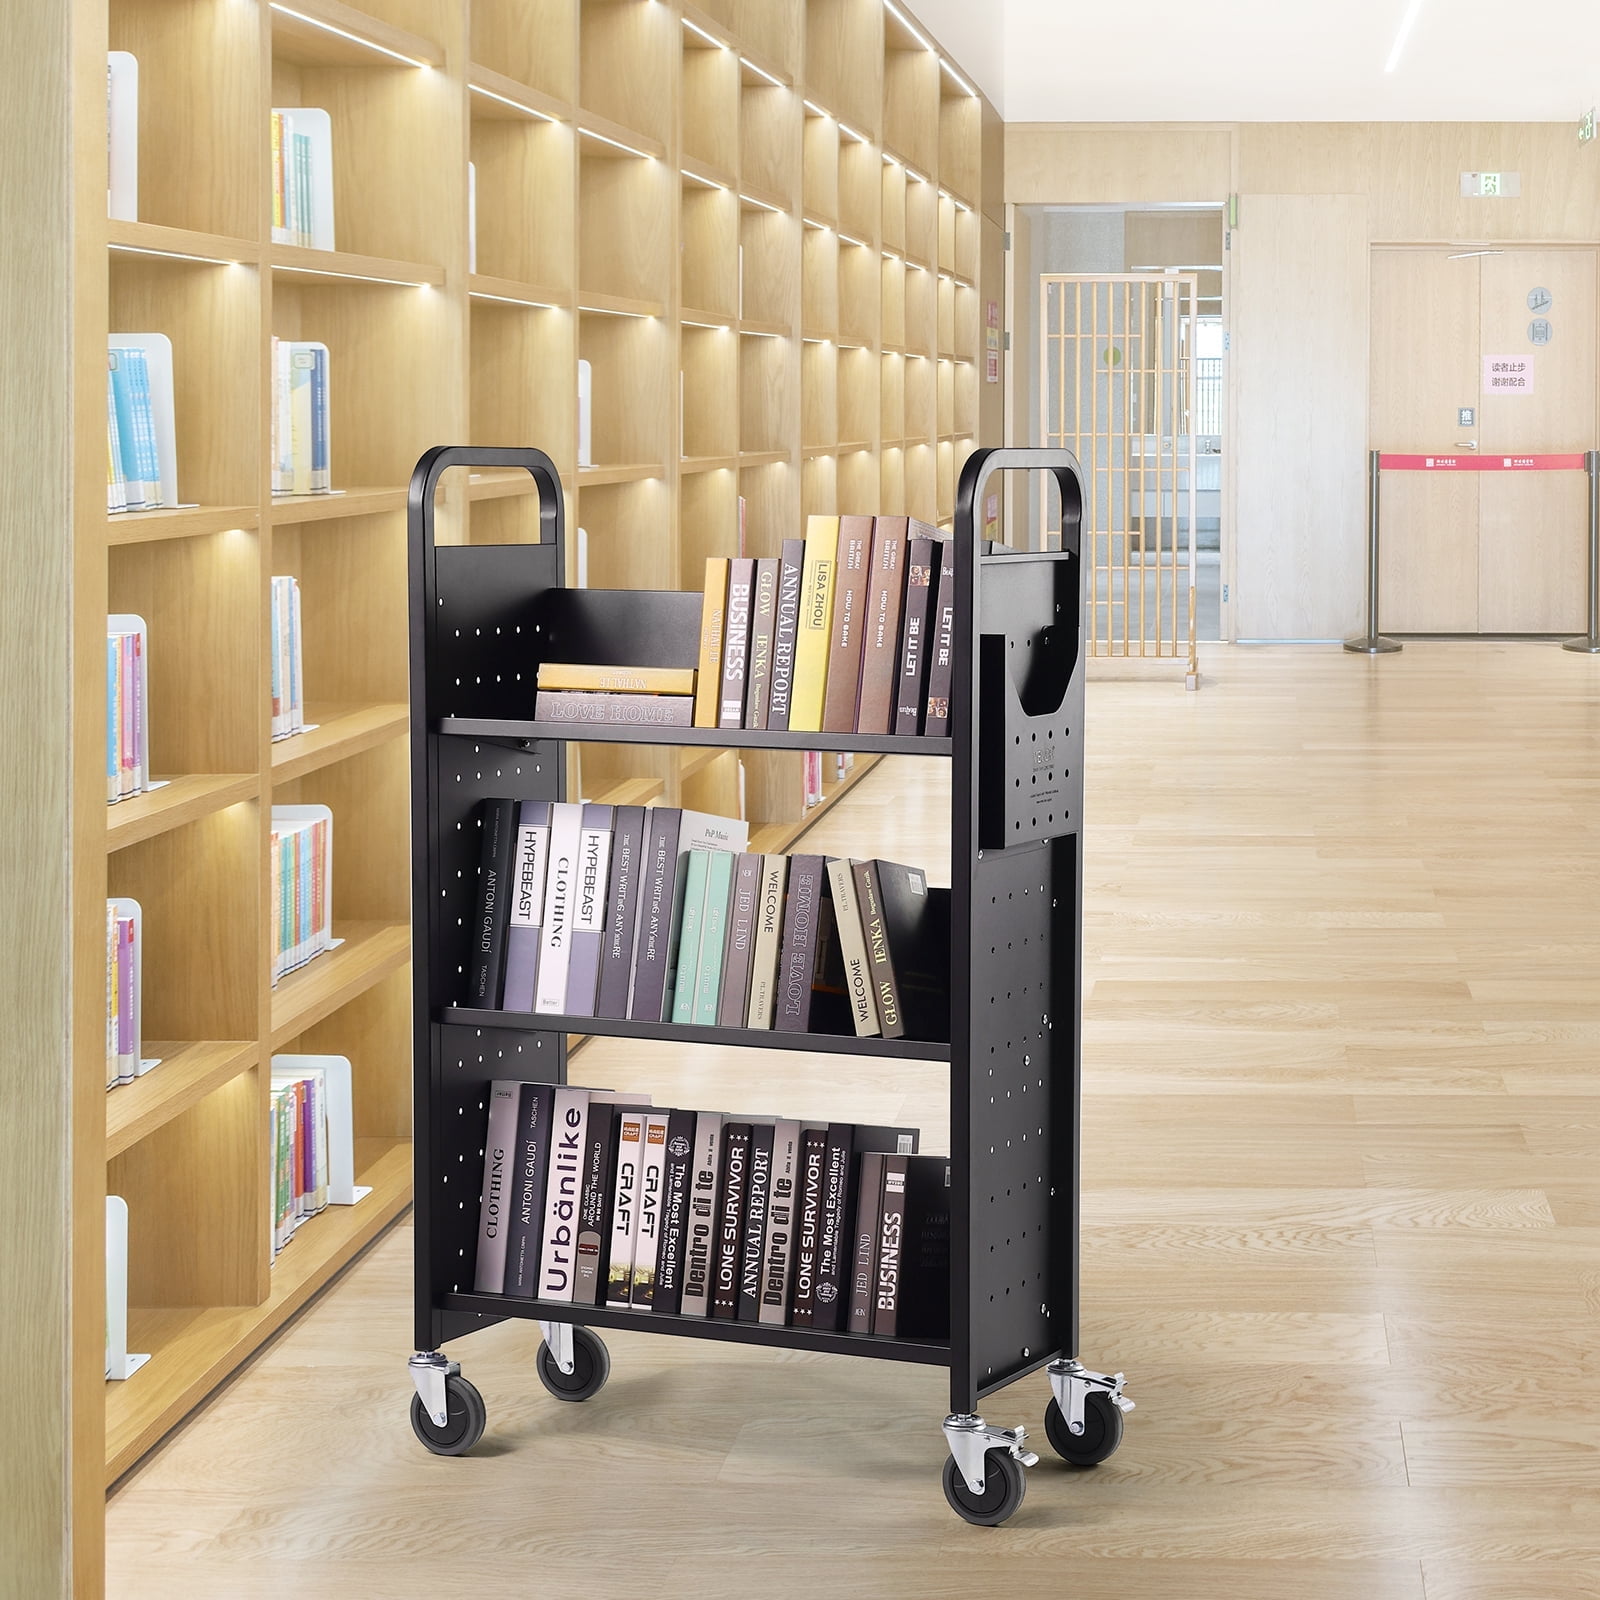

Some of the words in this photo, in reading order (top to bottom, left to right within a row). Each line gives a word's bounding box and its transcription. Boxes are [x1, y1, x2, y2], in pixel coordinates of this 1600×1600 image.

[1491, 362, 1526, 373] 读者止步
[1491, 377, 1526, 387] 谢谢配合
[816, 563, 828, 591] LISA
[779, 563, 800, 638] ANNUAL
[812, 593, 825, 627] ZHOU
[843, 612, 851, 622] TO
[845, 590, 853, 611] HOW
[878, 612, 886, 622] TO
[880, 590, 888, 611] HOW
[726, 584, 749, 681] BUSINESS
[908, 617, 920, 635] BE
[942, 607, 953, 631] LET
[841, 625, 849, 648] BAKE
[876, 625, 884, 648] BAKE
[907, 637, 918, 650] IT
[940, 633, 950, 646] IT
[754, 634, 768, 679] IENKA
[905, 652, 917, 676] LET
[938, 649, 948, 666] BE
[771, 642, 791, 715] REPORT
[551, 703, 604, 720] LOVE
[610, 705, 674, 722] HOME
[518, 831, 537, 920] HYPEBEAST
[620, 848, 630, 873] BEST
[655, 850, 666, 875] BEST
[485, 869, 497, 913] ANTONI
[581, 835, 600, 924] HYPEBEAST
[551, 857, 569, 948] CLOTHING
[739, 889, 751, 912] JED
[764, 871, 779, 933] WELCOME
[792, 874, 813, 947] HOME
[735, 919, 748, 950] LIND
[869, 918, 887, 964] IENKA
[479, 964, 488, 997] TASCHEN
[786, 953, 805, 1016] LOVE
[850, 959, 869, 1022] WELCOME
[521, 1180, 534, 1224] ANTONI
[530, 1097, 538, 1129] TASCHEN
[592, 1142, 602, 1172] WORLD
[591, 1174, 599, 1190] THE
[674, 1163, 686, 1188] The
[696, 1170, 714, 1190] te
[749, 1148, 769, 1220] REPORT
[774, 1178, 792, 1198] te
[825, 1147, 841, 1209] Excellent
[486, 1148, 504, 1239] CLOTHING
[546, 1107, 581, 1291] Urbänlike
[587, 1192, 597, 1227] AROUND
[617, 1163, 634, 1236] CRAFT
[642, 1165, 659, 1238] CRAFT
[670, 1192, 682, 1225] Most
[692, 1198, 711, 1217] di
[724, 1147, 744, 1240] SURVIVOR
[802, 1154, 821, 1248] SURVIVOR
[770, 1205, 790, 1225] di
[822, 1213, 835, 1246] Most
[664, 1228, 680, 1289] Excellent
[685, 1224, 709, 1297] Dentro
[743, 1224, 763, 1298] ANNUAL
[820, 1249, 831, 1275] The
[858, 1233, 871, 1265] LIND
[878, 1212, 902, 1311] BUSINESS
[720, 1243, 735, 1290] LONE
[763, 1232, 788, 1306] Dentro
[798, 1252, 813, 1299] LONE
[856, 1272, 868, 1296] JED
